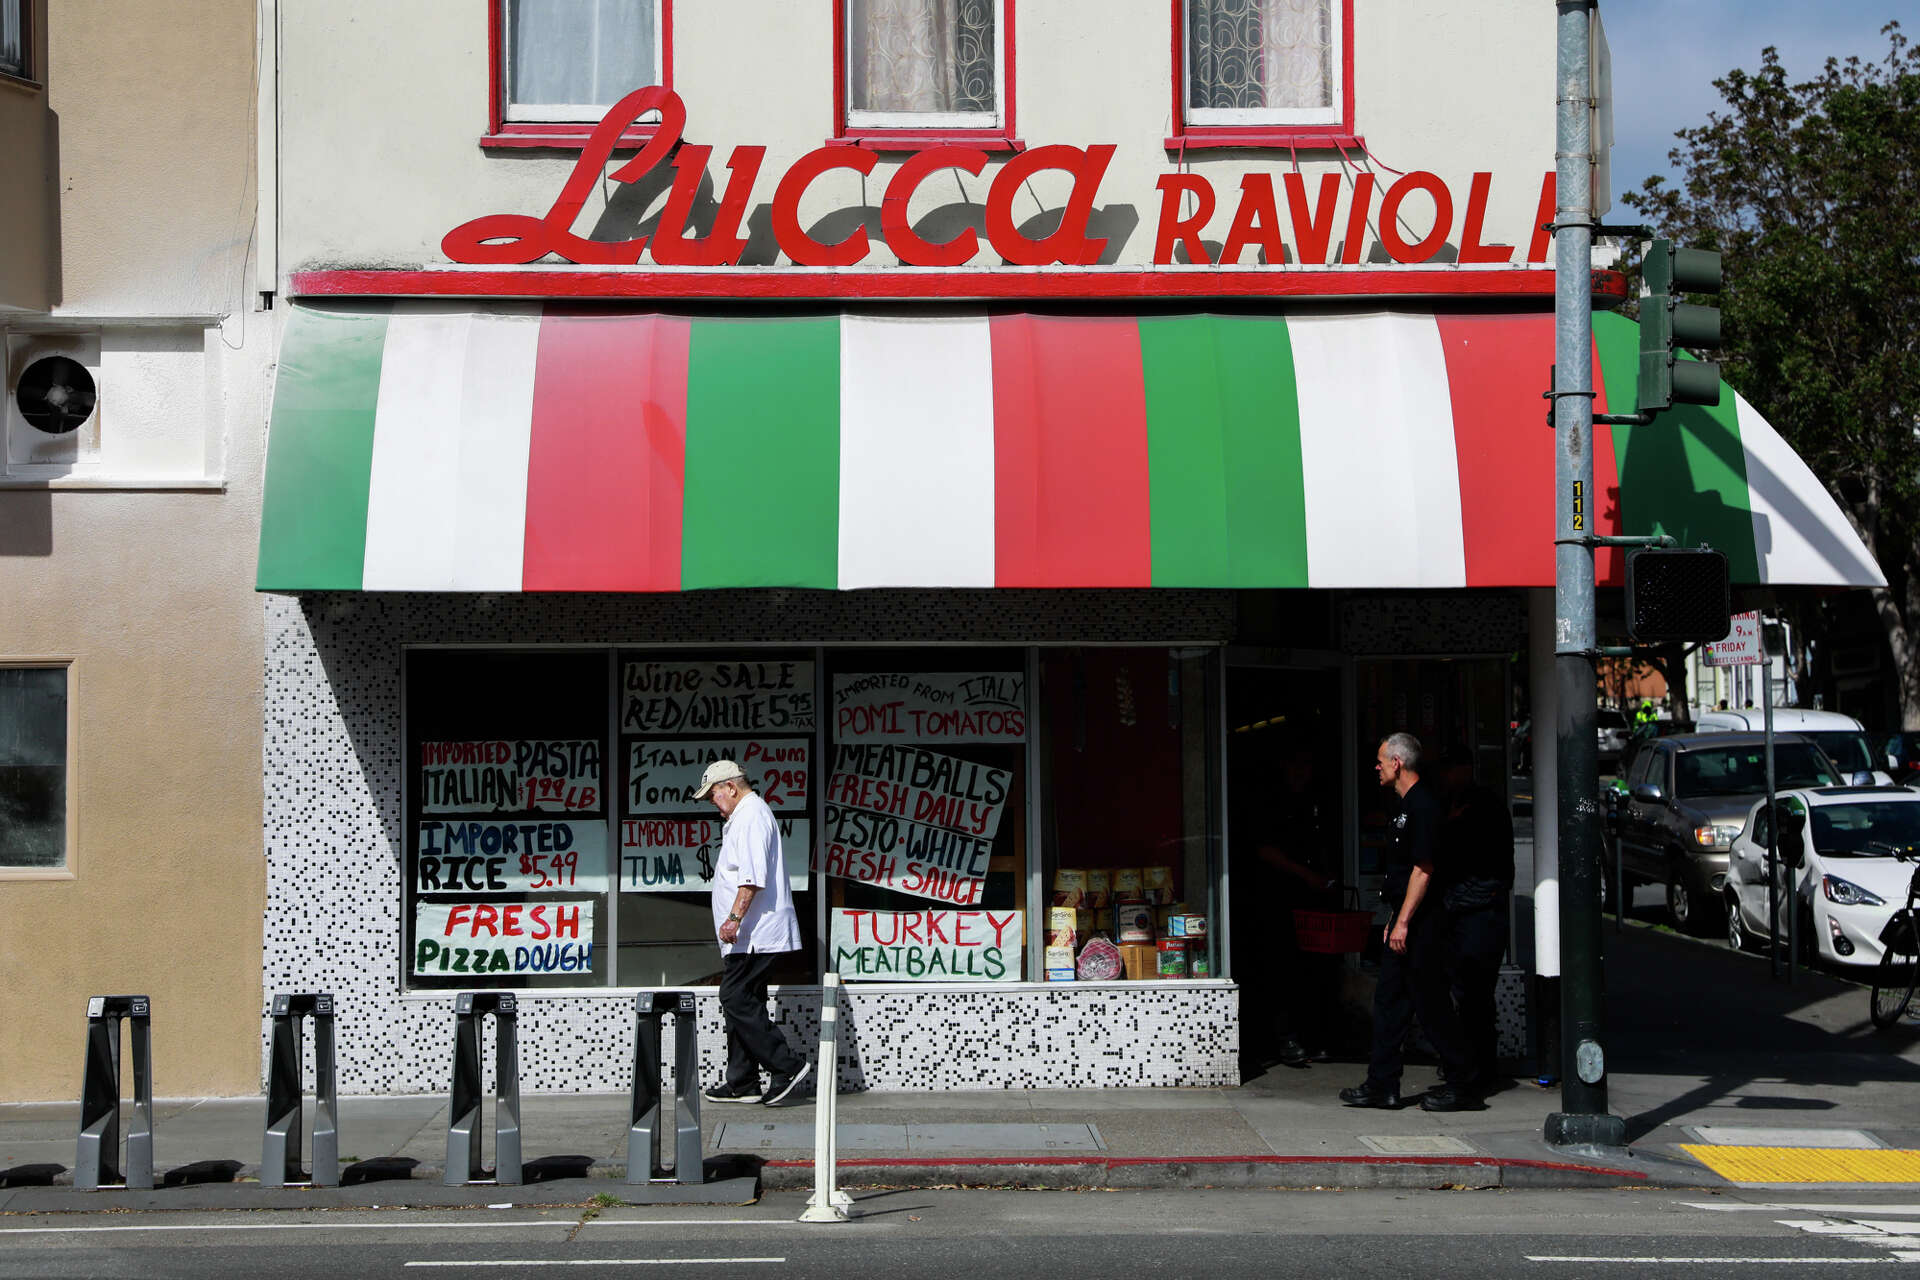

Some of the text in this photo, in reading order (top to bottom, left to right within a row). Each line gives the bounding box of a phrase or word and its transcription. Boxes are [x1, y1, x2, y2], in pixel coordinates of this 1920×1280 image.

[441, 85, 1557, 266] Lucca RAVIOLI
[1574, 482, 1583, 530] 112
[1715, 642, 1746, 653] FRIDAY
[627, 663, 795, 692] Wine SALE
[835, 674, 1024, 705] IMPORTED FROM ITALY
[624, 691, 767, 733] RED/WHITE
[838, 701, 1025, 738] POMI TOMATOES
[421, 740, 600, 780] IMPORTED PASTA
[633, 742, 806, 769] ITALIAN PLUM
[423, 767, 517, 807] ITALIAN
[564, 786, 596, 809] LB
[837, 744, 1005, 806] MEATBALLS
[827, 773, 993, 835] FRESH DAILY
[421, 822, 574, 855] IMPORTED
[622, 820, 711, 848] IMPORTED
[420, 851, 578, 890] RICE $5.49
[624, 852, 685, 886] TUNA
[444, 904, 579, 940] FRESH
[842, 909, 1016, 949] TURKEY
[417, 938, 593, 973] PIZZA DOUGH
[836, 945, 1006, 980] MEATBALLS
